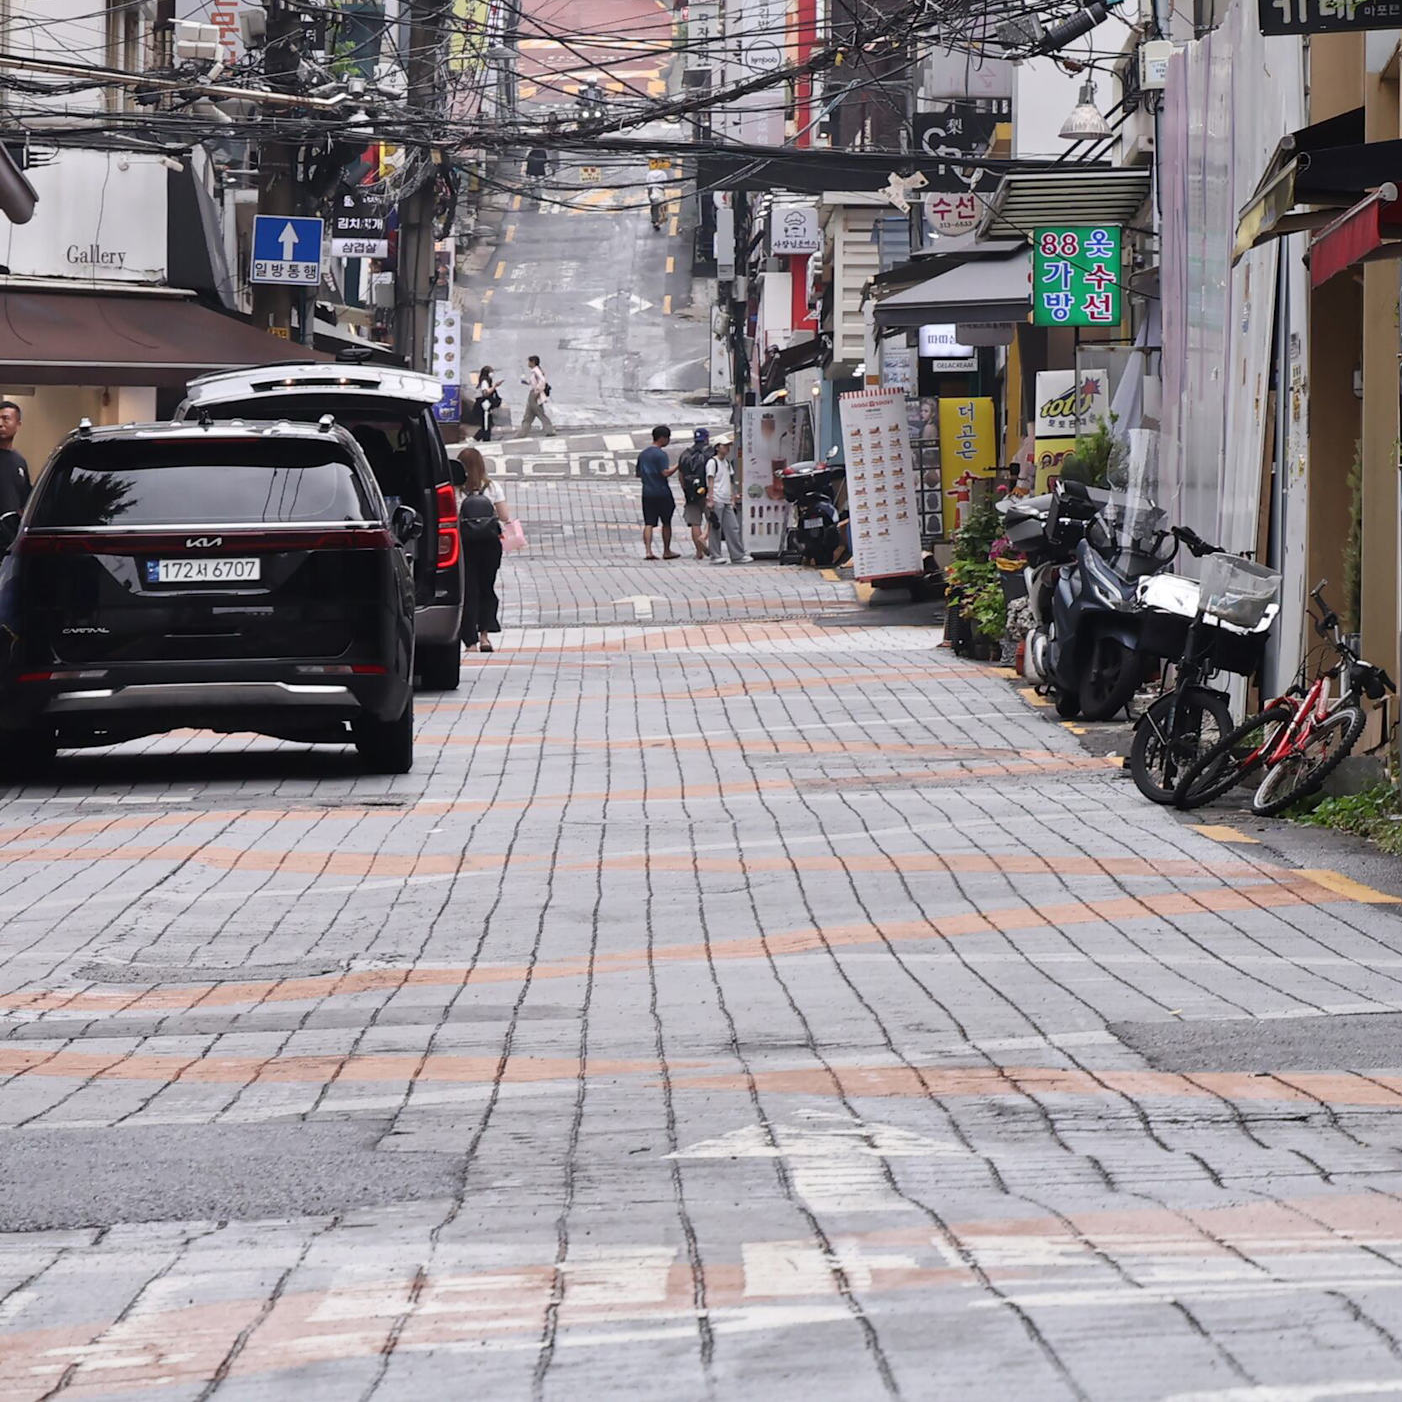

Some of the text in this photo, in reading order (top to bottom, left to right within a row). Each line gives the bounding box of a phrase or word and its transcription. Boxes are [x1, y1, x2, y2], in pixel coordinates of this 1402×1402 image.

[933, 195, 976, 221] 수선
[66, 244, 127, 268] Gallery
[342, 242, 377, 254] 삼겹살
[255, 262, 317, 280] 일방통행
[1040, 232, 1079, 322] 88 가방
[1080, 229, 1117, 322] 옷수선
[956, 401, 977, 460] 더고은
[186, 537, 222, 548] KIA
[212, 561, 256, 578] 6707
